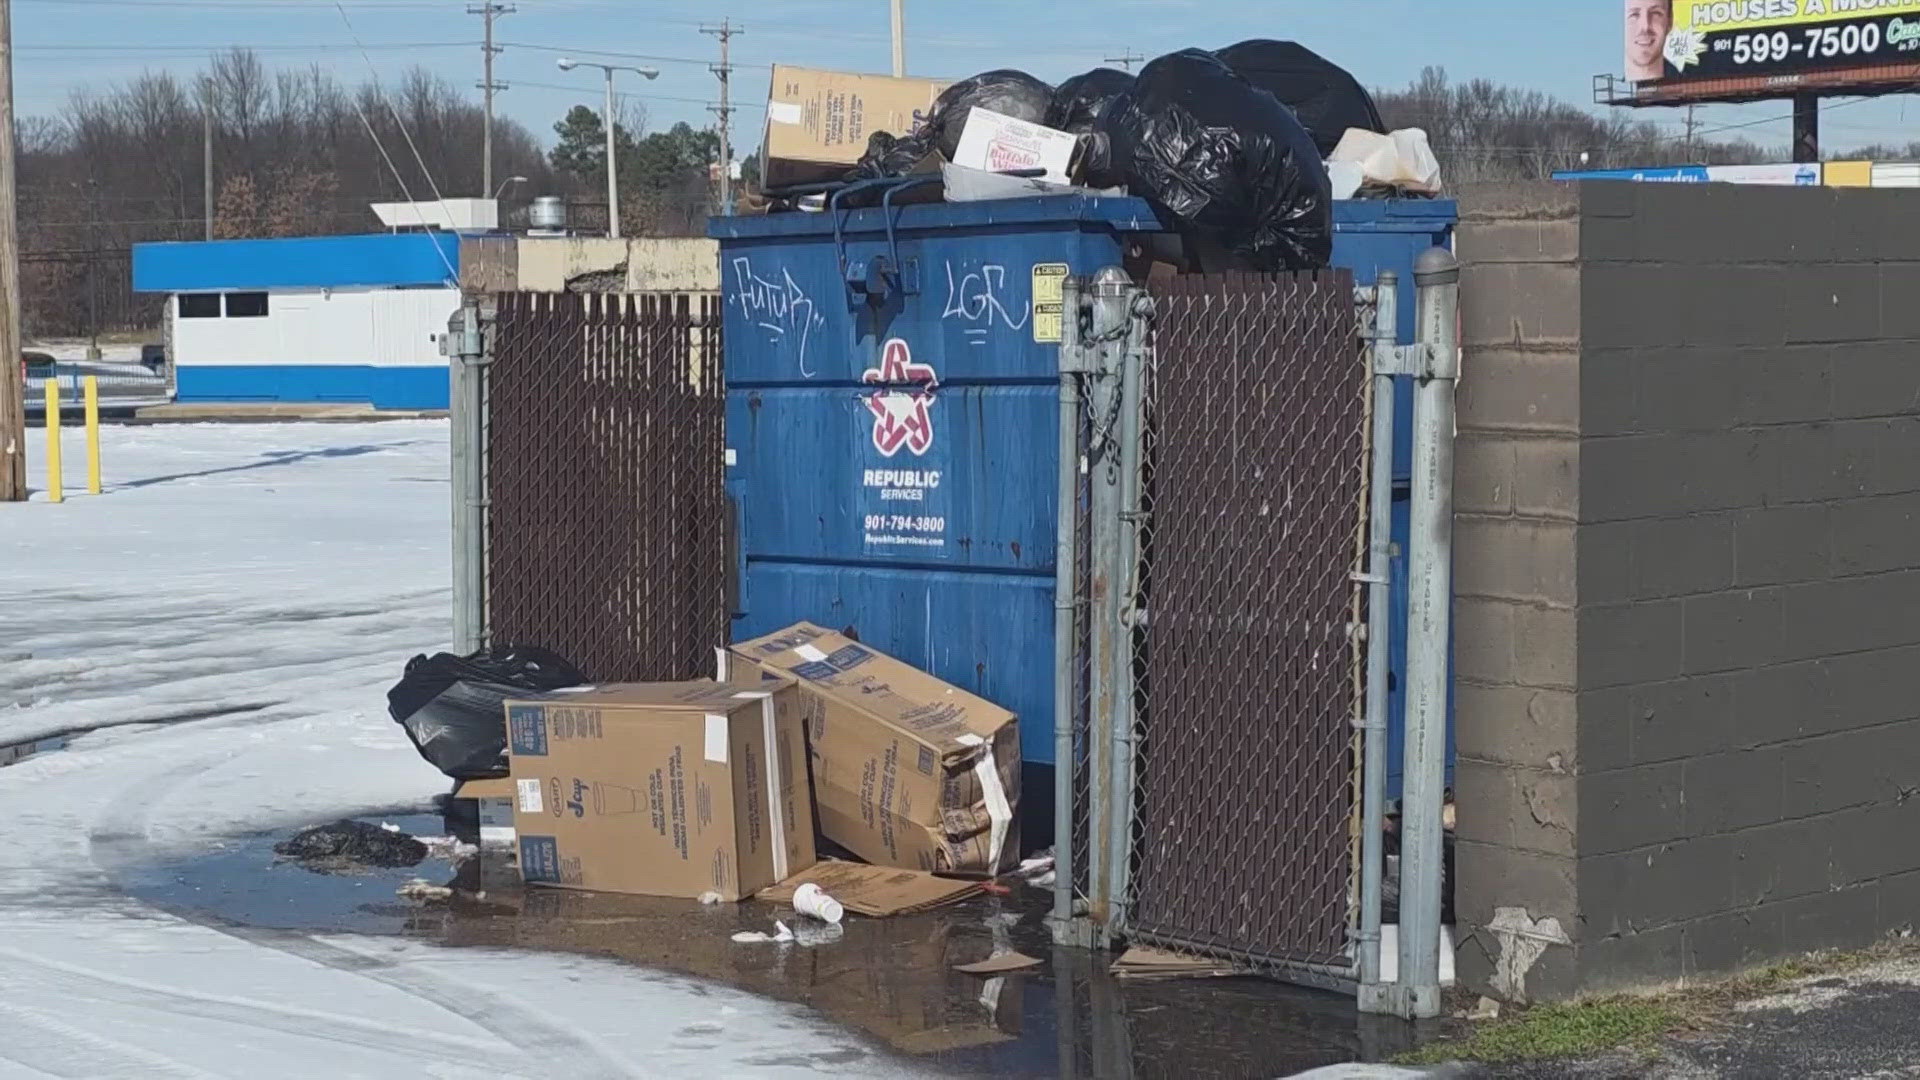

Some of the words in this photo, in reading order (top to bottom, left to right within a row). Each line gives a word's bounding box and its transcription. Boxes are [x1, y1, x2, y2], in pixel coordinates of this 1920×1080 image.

[1692, 0, 1799, 25] HOUSES
[1802, 0, 1826, 15] A
[1669, 36, 1688, 47] CALL
[1713, 38, 1732, 52] 901
[1733, 22, 1880, 64] 599-7500
[863, 469, 940, 488] REPUBLIC
[881, 489, 923, 500] SERVICES
[864, 515, 945, 532] 901-794-3800
[865, 533, 945, 547] RepublicServices.com
